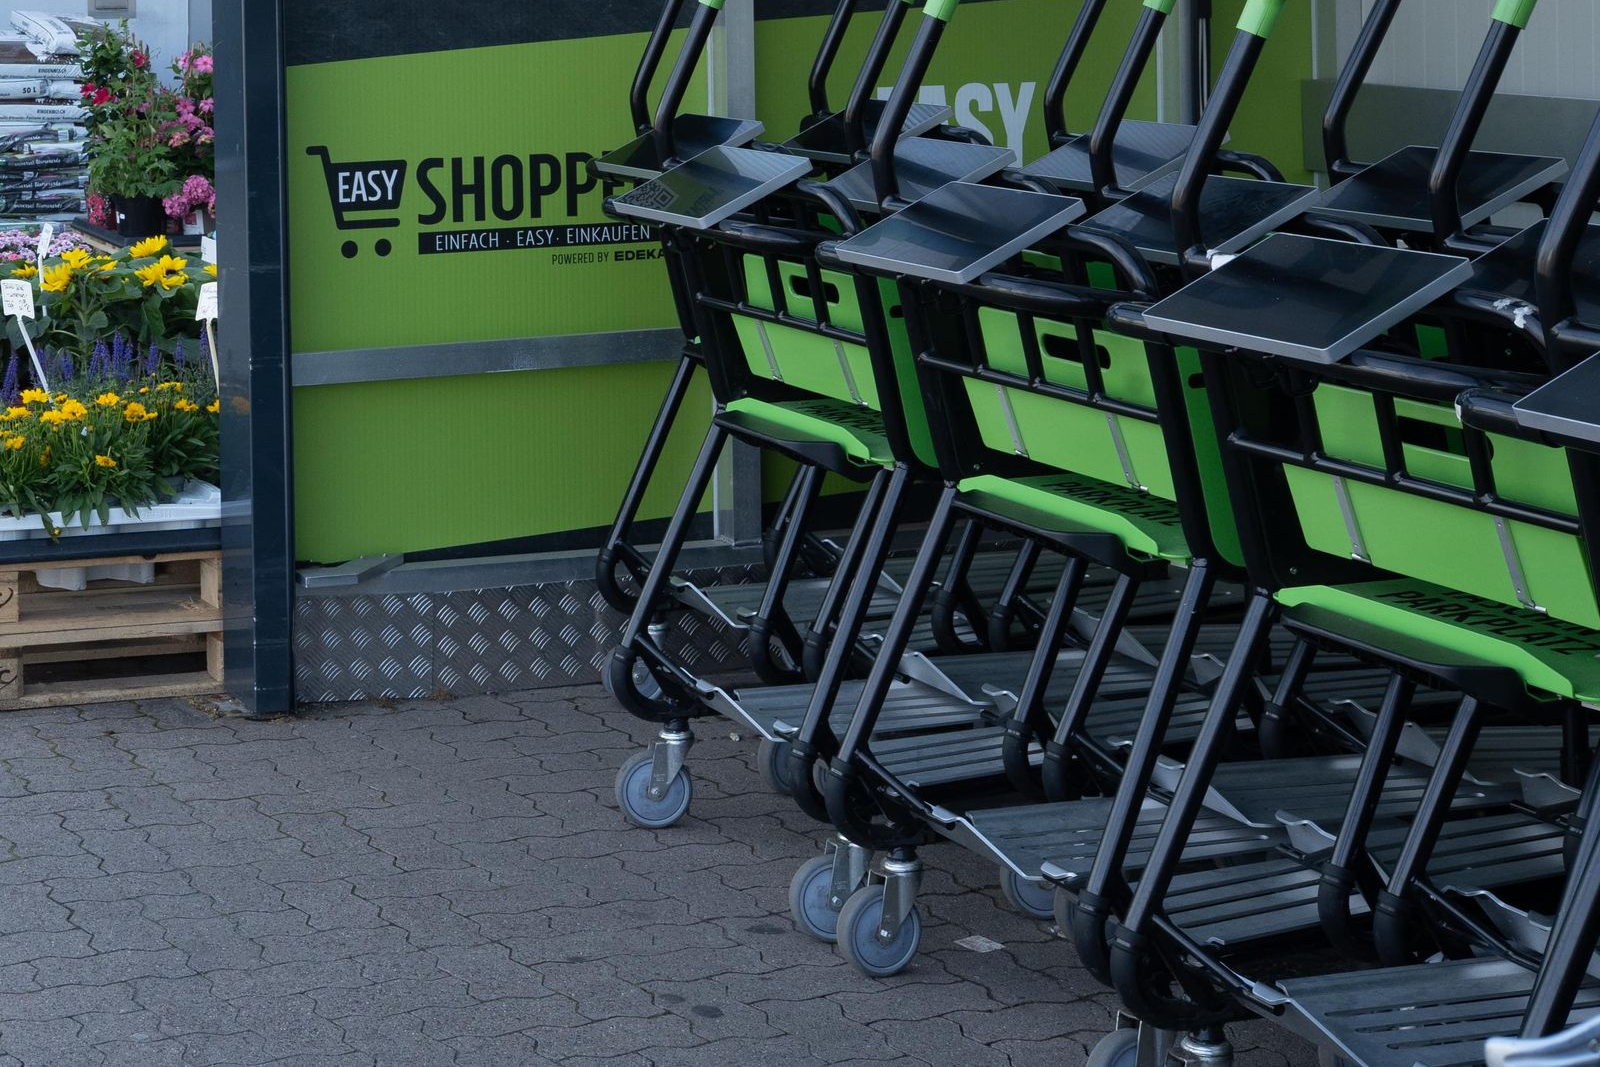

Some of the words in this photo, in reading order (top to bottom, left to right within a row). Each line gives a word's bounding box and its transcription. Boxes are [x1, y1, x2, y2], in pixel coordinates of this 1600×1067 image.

[338, 169, 398, 203] EASY
[435, 232, 499, 252] EINFACH
[517, 229, 554, 247] EASY
[566, 224, 651, 245] EINKAUFEN
[552, 252, 595, 265] POWERED
[598, 252, 609, 263] BY
[1376, 590, 1600, 655] PARKPLATZ
